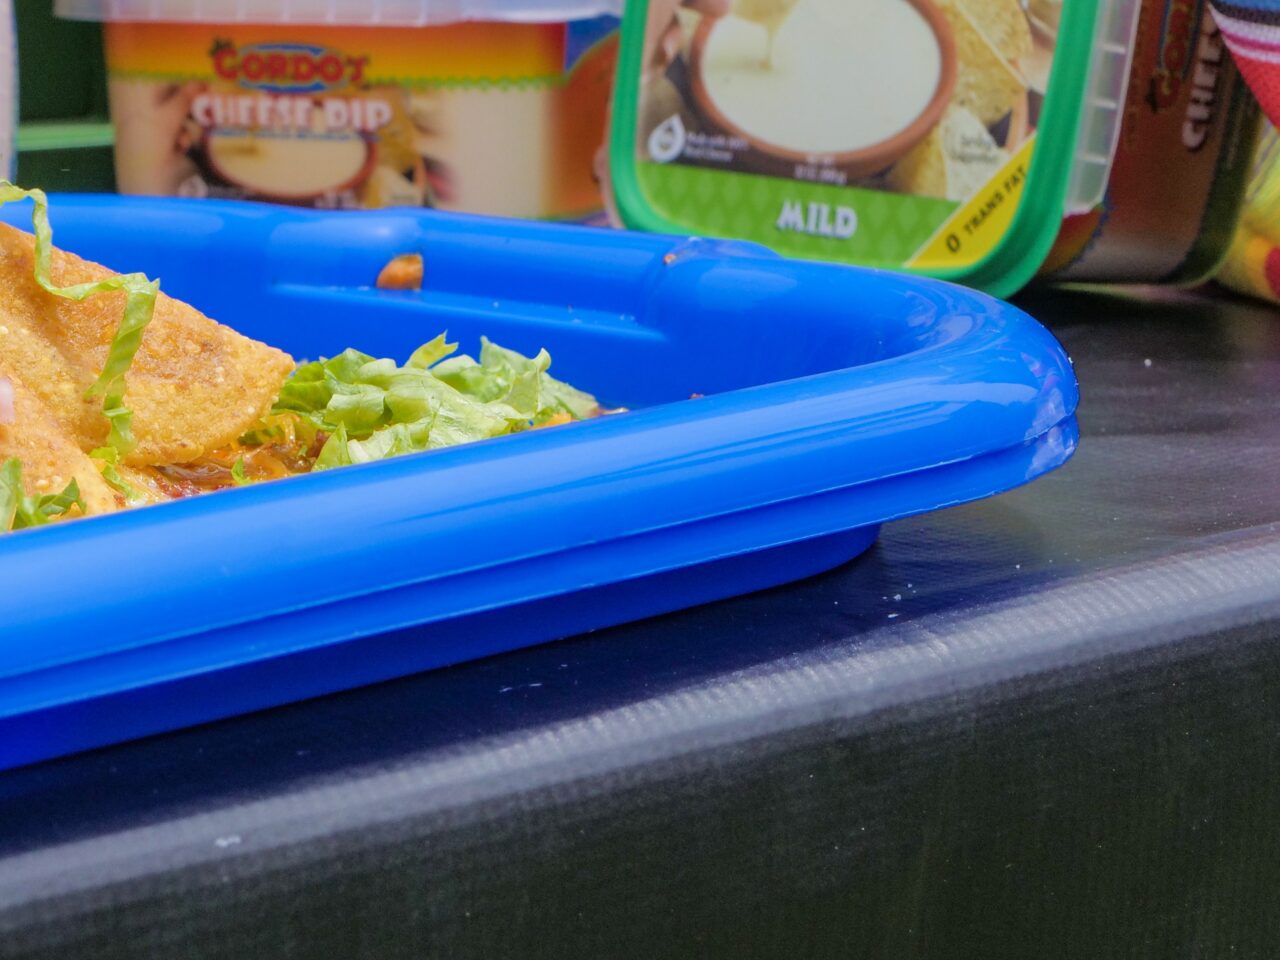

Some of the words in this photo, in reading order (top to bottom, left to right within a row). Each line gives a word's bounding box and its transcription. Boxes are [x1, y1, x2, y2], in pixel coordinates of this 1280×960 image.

[190, 96, 317, 130] CHEESE
[322, 100, 393, 131] DIP
[776, 198, 857, 240] MILD
[963, 191, 1004, 236] TRANS
